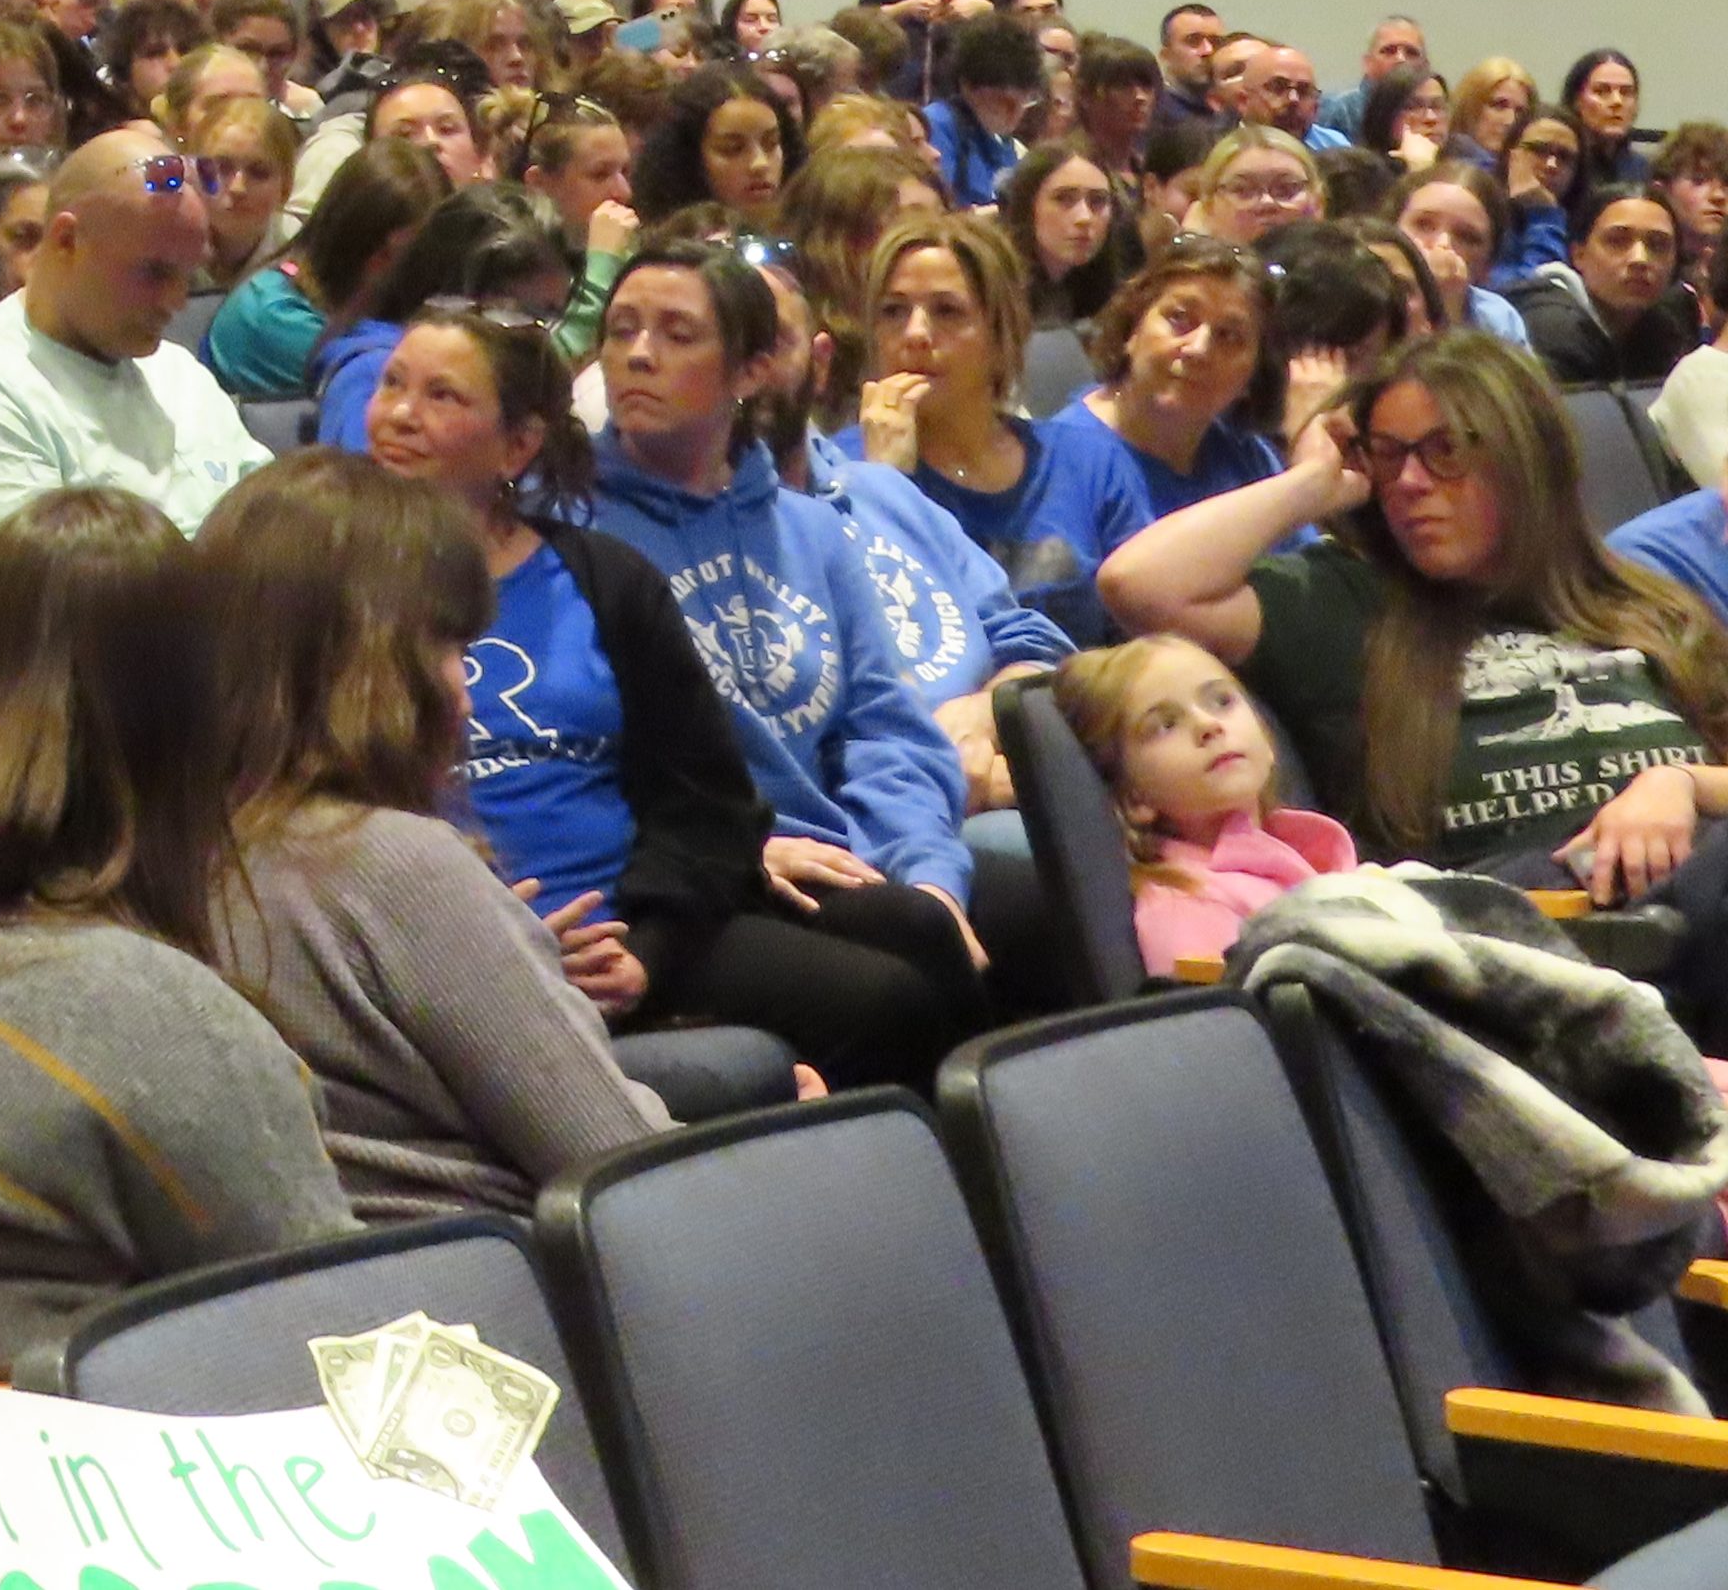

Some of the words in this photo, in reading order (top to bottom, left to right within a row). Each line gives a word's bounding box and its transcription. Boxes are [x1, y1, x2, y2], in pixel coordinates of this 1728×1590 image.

[1482, 760, 1582, 795] THIS
[1444, 782, 1616, 829] HELPED
[39, 1430, 163, 1570] in
[159, 1428, 376, 1568] the
